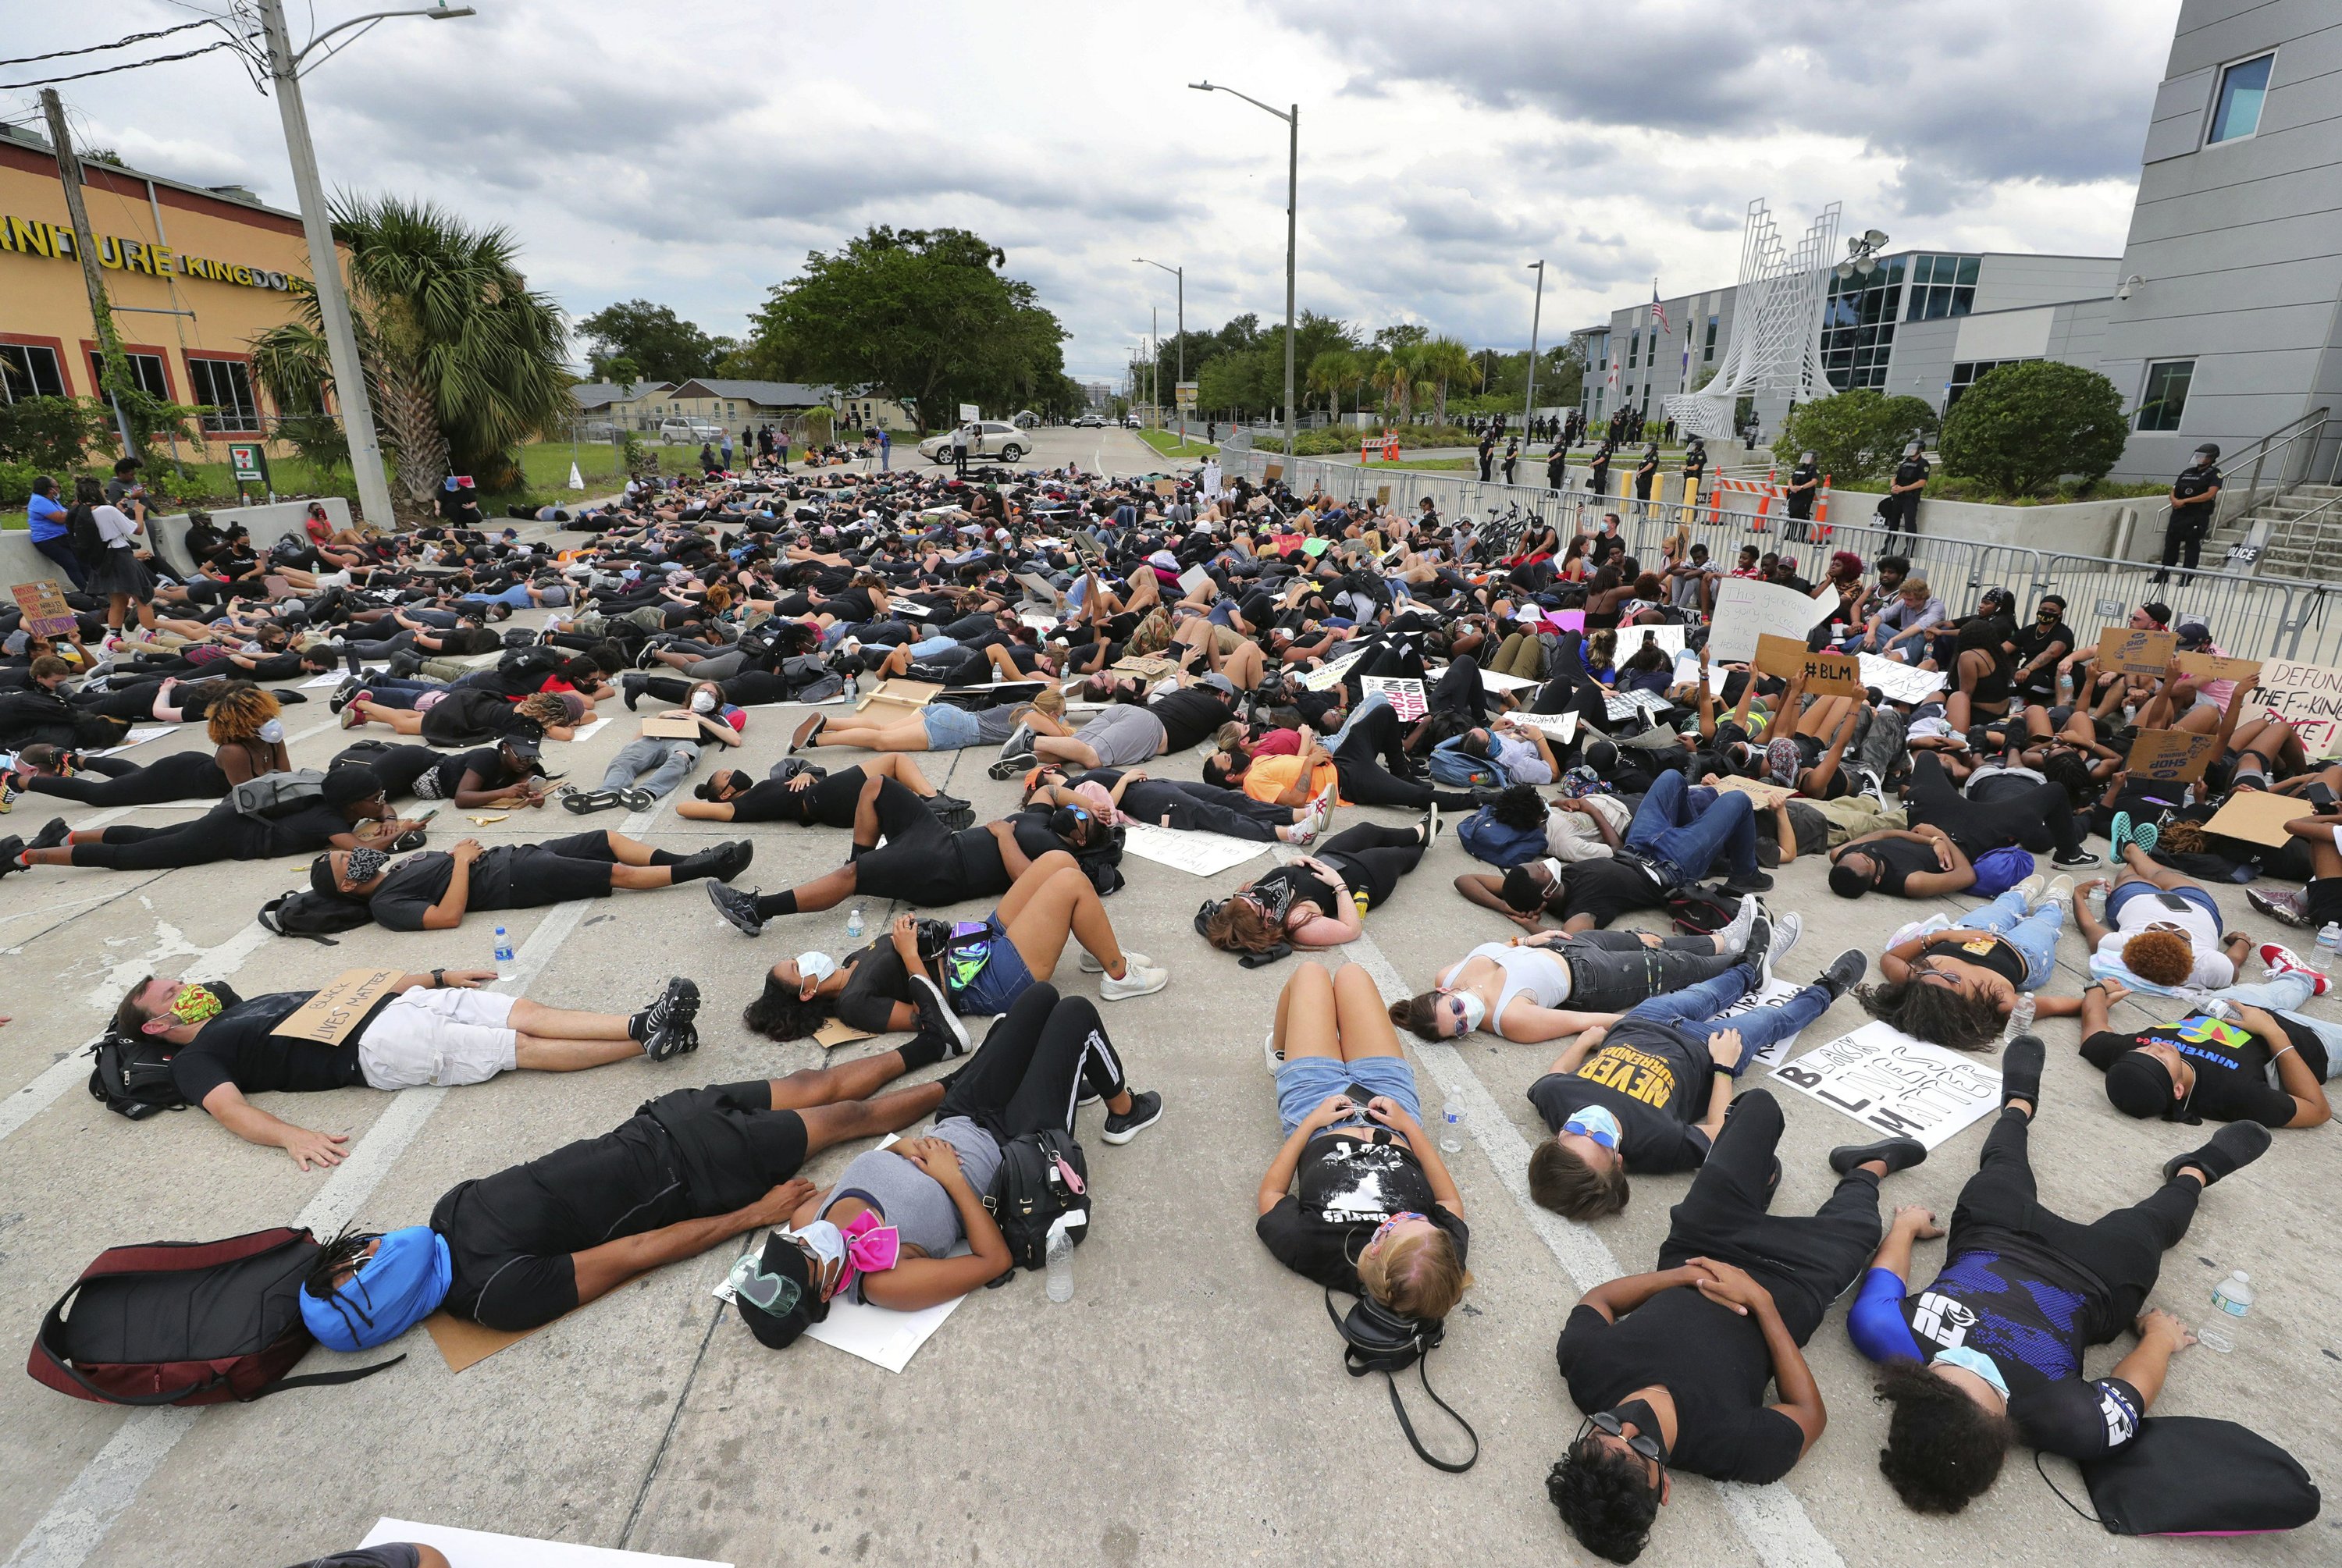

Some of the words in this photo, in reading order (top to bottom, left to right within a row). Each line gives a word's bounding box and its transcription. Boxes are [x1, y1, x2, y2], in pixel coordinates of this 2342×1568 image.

[2226, 546, 2256, 560] OLICE
[1726, 587, 1756, 600] This
[27, 604, 39, 613] NO
[1679, 610, 1701, 626] ACK
[1735, 609, 1760, 623] going
[1764, 612, 1775, 622] to
[1732, 624, 1752, 637] the
[2127, 638, 2148, 647] SHOP
[1805, 662, 1851, 681] #BLM
[2271, 664, 2342, 693] DEFUN
[1383, 680, 1400, 692] NO
[1402, 681, 1421, 692] NO
[2251, 687, 2286, 707] THE
[1516, 713, 1564, 724] UNARMED
[2149, 759, 2187, 769] SHOP
[309, 982, 351, 1009] BLACK
[310, 1011, 350, 1040] LIVES
[346, 971, 391, 1007] MATTER
[2136, 1036, 2152, 1045] 64
[2150, 1036, 2240, 1070] NINTENDO
[1776, 1036, 1881, 1089] BLACK
[1577, 1056, 1670, 1109] NEVER
[1816, 1046, 1947, 1113] LIVES
[1867, 1064, 2003, 1139] MATTER
[1322, 1210, 1390, 1224] BEATLES
